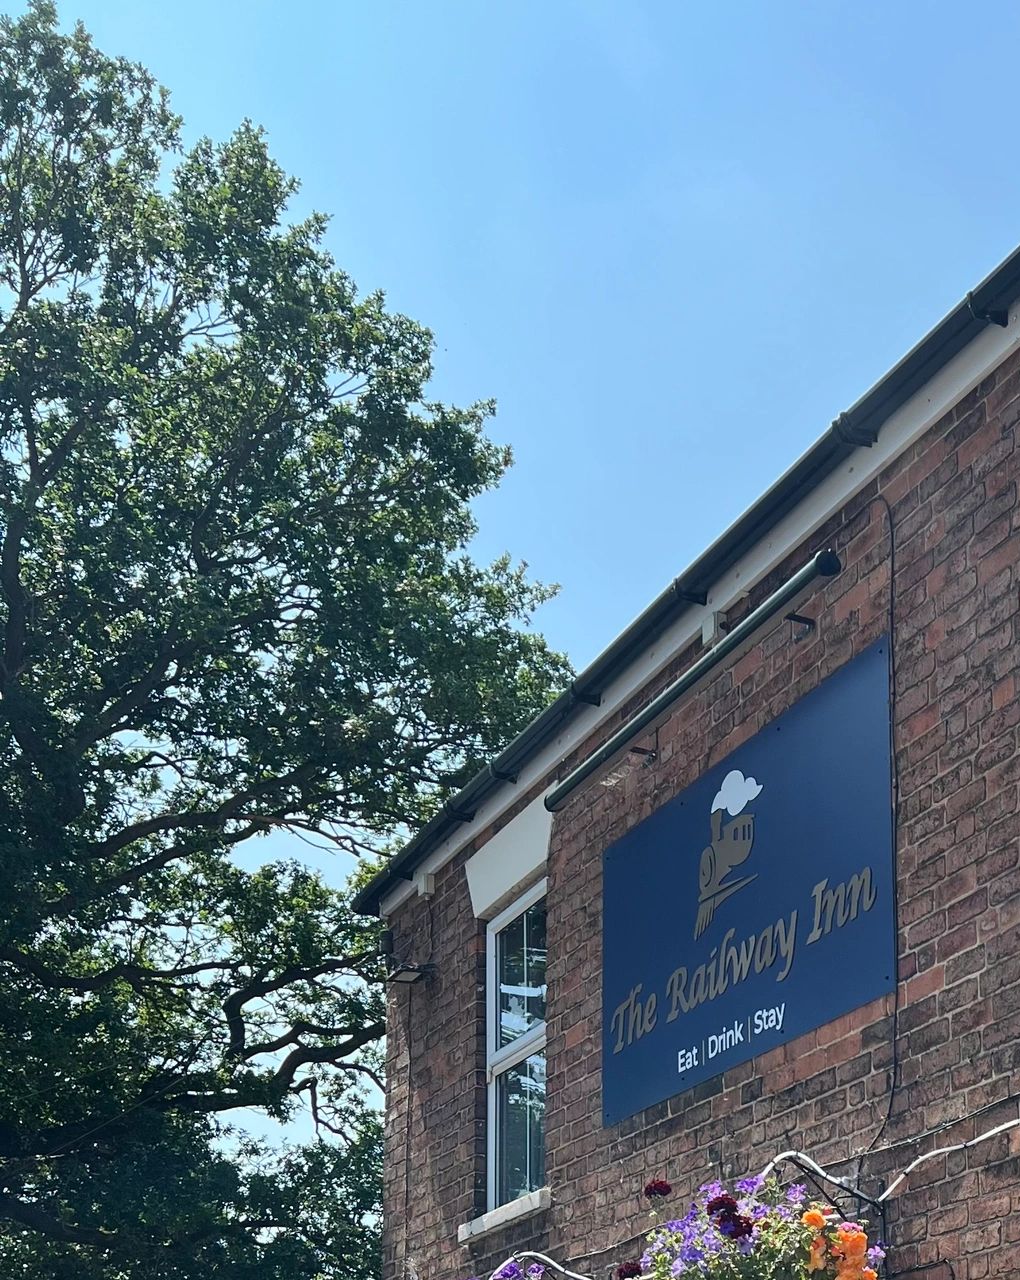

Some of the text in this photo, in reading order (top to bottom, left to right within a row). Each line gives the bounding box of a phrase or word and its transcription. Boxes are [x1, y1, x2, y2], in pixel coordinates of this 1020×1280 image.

[610, 866, 877, 1054] The Railway Inn
[678, 1003, 786, 1073] Eat Drink Stay
